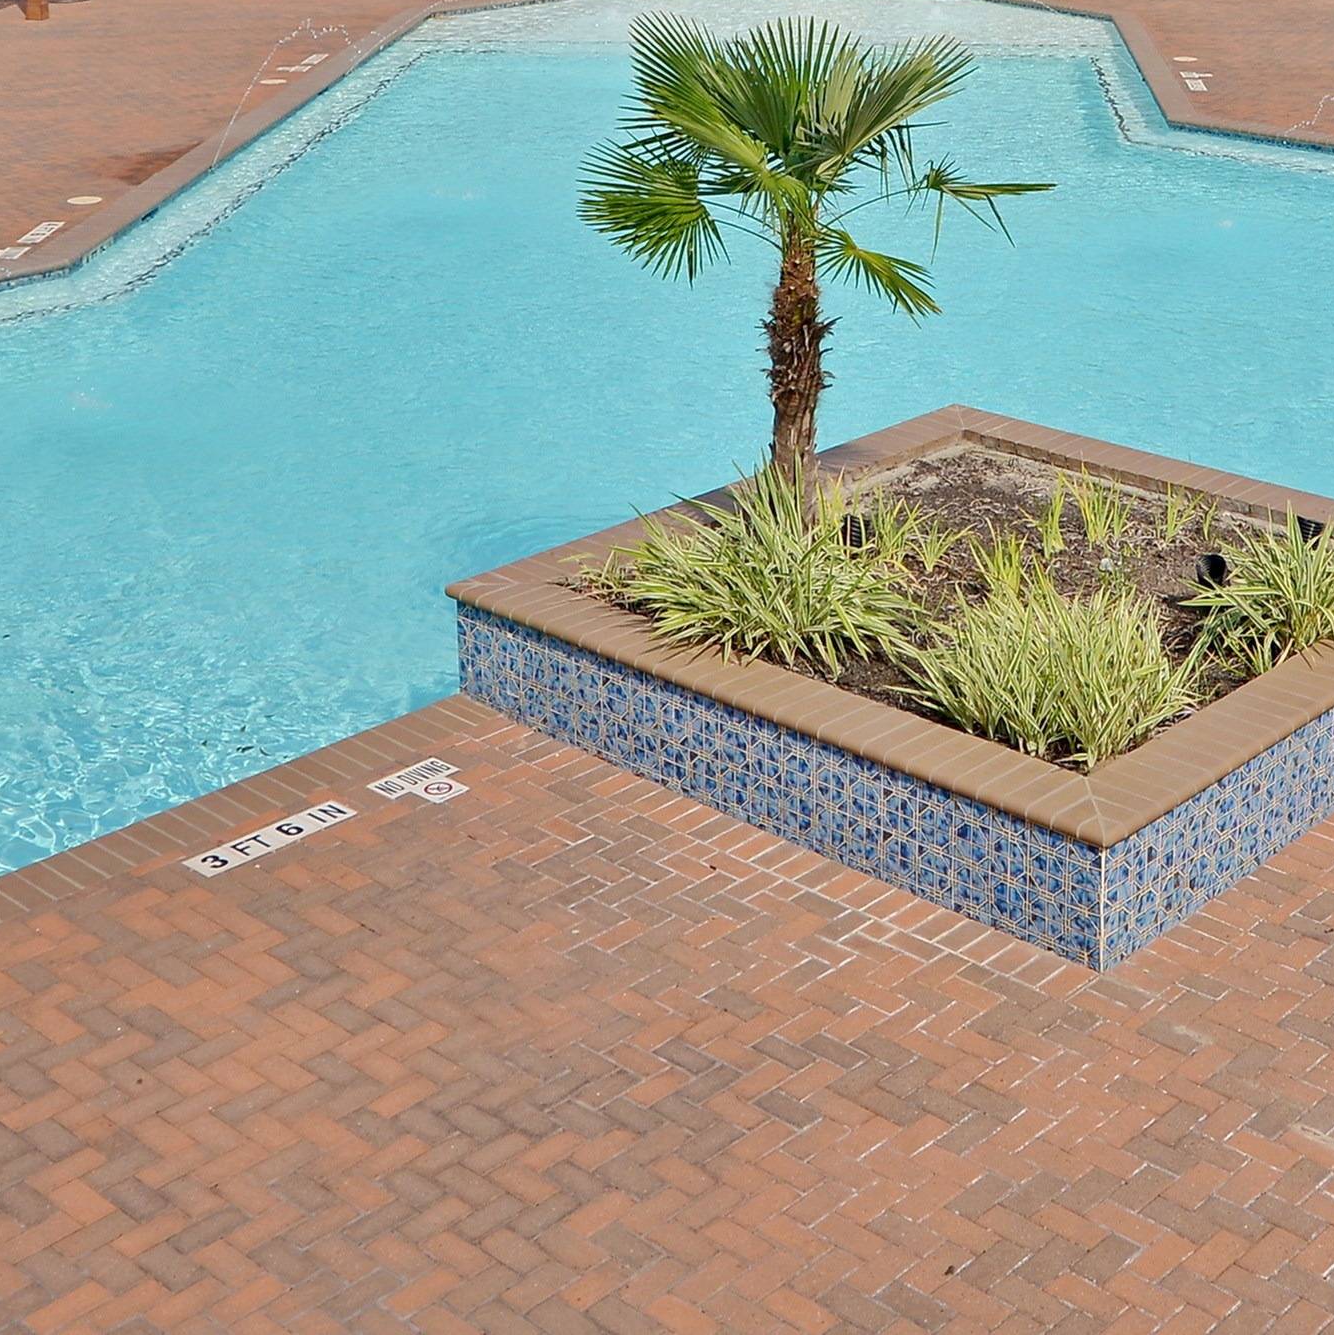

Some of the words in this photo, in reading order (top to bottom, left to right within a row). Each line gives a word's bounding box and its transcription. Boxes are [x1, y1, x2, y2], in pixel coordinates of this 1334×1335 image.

[374, 780, 406, 796] NO
[396, 760, 452, 786] DIVING
[200, 854, 229, 870] 3
[230, 834, 272, 857] FT
[274, 822, 305, 837] 6
[306, 803, 349, 824] IN
